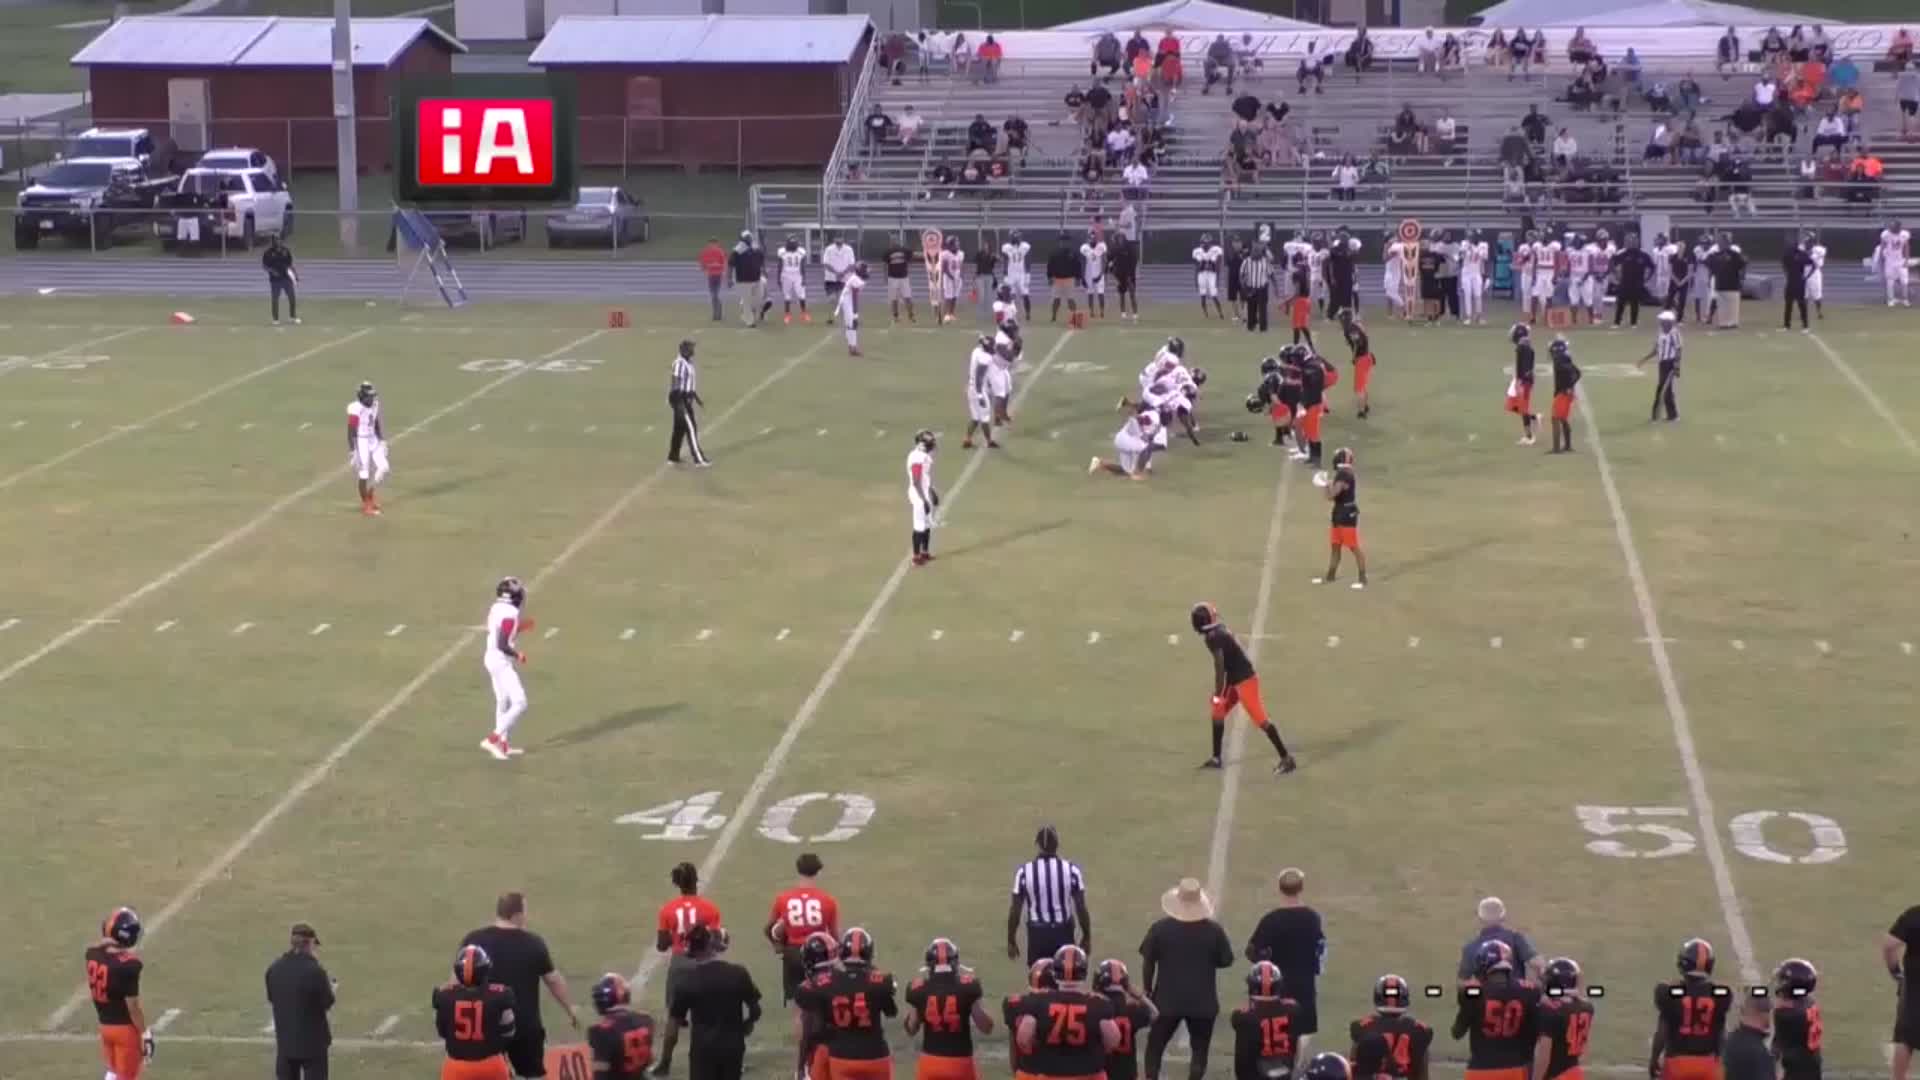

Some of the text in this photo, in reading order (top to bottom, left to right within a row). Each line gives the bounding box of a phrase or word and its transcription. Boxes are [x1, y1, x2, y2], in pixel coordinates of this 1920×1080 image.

[1259, 223, 1271, 241] 2
[614, 791, 876, 844] 40
[1575, 804, 1848, 865] 50
[786, 898, 823, 928] 26
[454, 999, 485, 1041] 51
[924, 994, 961, 1032] 44
[1046, 1002, 1088, 1046] 75
[1482, 999, 1524, 1039] 50
[1259, 1015, 1291, 1057] 15
